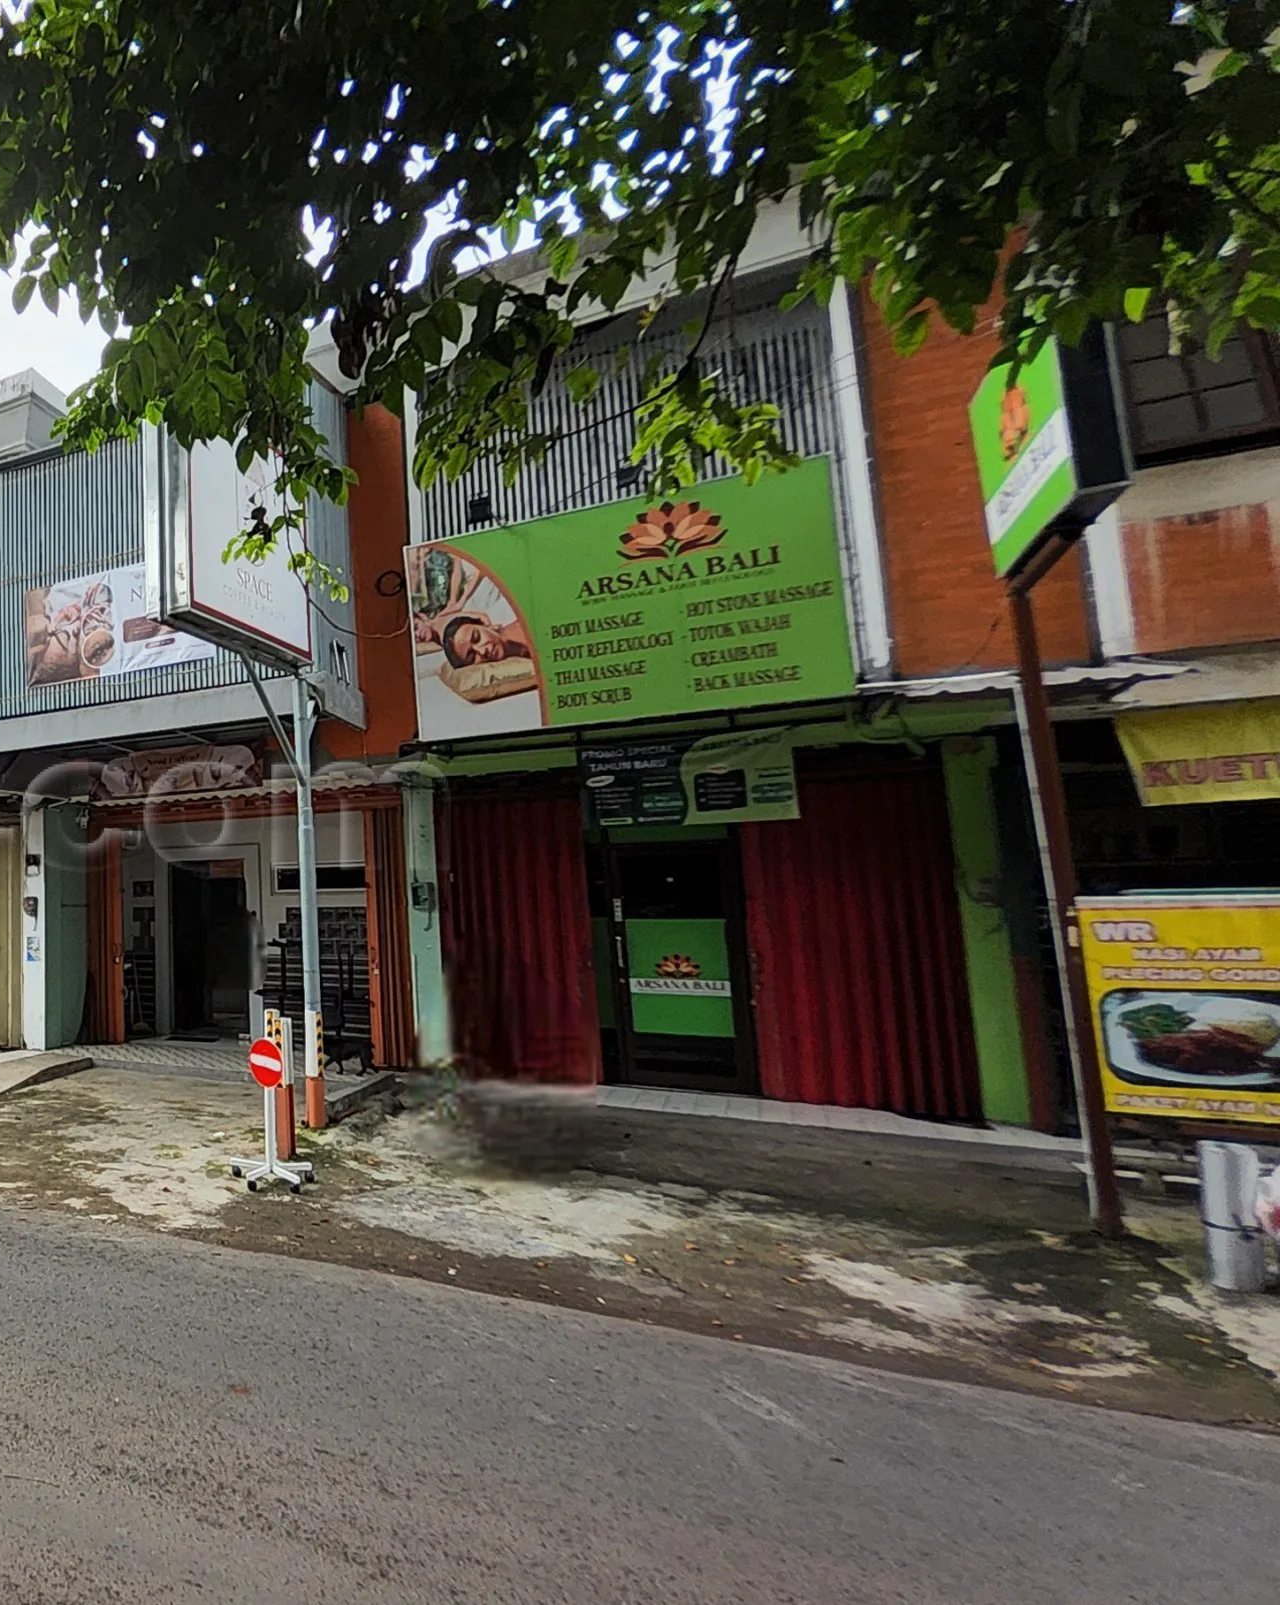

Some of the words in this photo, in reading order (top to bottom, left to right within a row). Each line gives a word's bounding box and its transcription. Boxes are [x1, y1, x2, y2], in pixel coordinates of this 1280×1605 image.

[236, 567, 273, 603] SPACE
[575, 562, 698, 599] ARSANA
[706, 545, 783, 576] BALI
[717, 591, 761, 614] STONE
[764, 579, 835, 601] MASSAGE
[551, 623, 583, 640] BODY
[586, 611, 645, 634] MASSAGE
[688, 624, 735, 643] TOTOK
[738, 612, 792, 634] WAJAH
[552, 648, 584, 664] FOOT
[587, 631, 674, 658] REFLEXOLOGY
[691, 642, 778, 668] CREAMBATH
[555, 670, 586, 687] THAI
[587, 660, 647, 683] MASSAGE
[694, 675, 731, 693] BACK
[734, 665, 802, 688] MASSAGE
[557, 693, 588, 710] BODY
[592, 687, 632, 705] SCRUB
[582, 749, 624, 760] PROMO
[627, 744, 676, 757] SPECIAL
[589, 761, 632, 773] TAHUN
[1141, 752, 1280, 787] KUET
[1191, 947, 1263, 961] AYAM
[635, 979, 689, 990] ARSANA
[693, 981, 726, 991] BALI
[1195, 1097, 1257, 1114] AYAM
